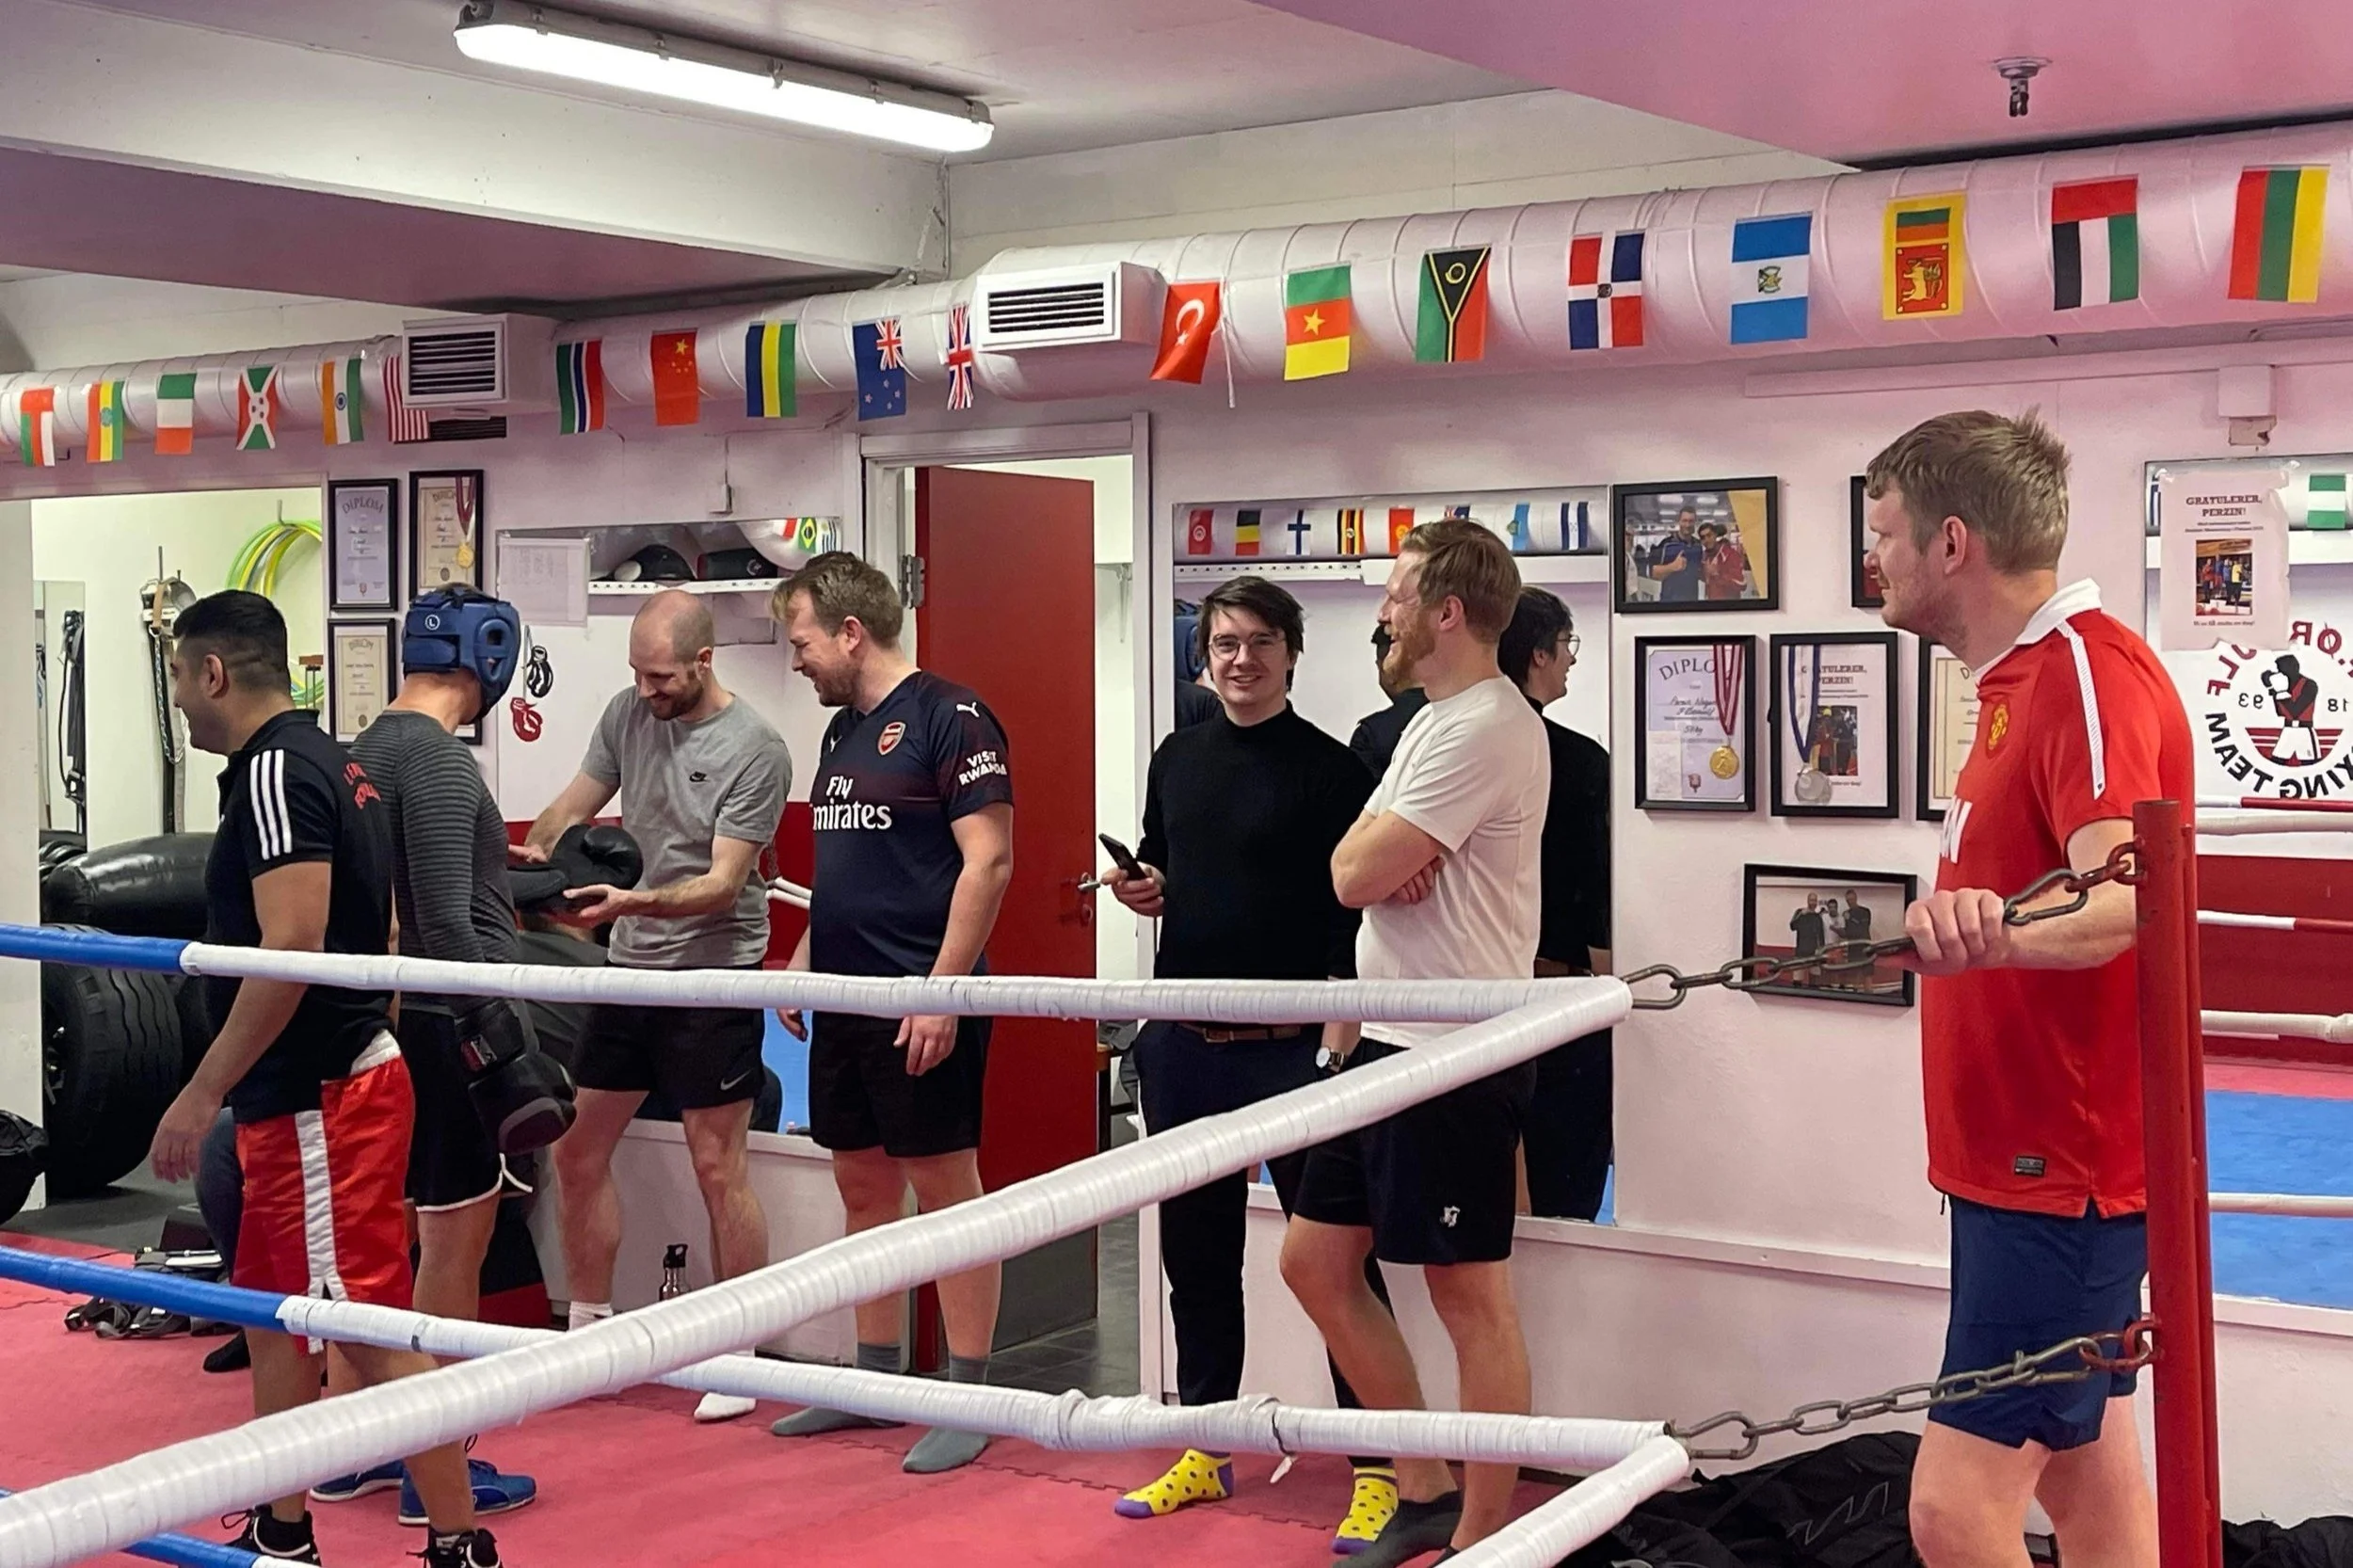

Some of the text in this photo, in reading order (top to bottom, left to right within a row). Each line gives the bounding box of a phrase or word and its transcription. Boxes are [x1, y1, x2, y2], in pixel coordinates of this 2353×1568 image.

[2185, 494, 2263, 506] GRATULERER,
[966, 750, 997, 769] VISIT
[958, 762, 1007, 786] RWANDA
[825, 775, 854, 800] Fly
[810, 798, 892, 830] mirates
